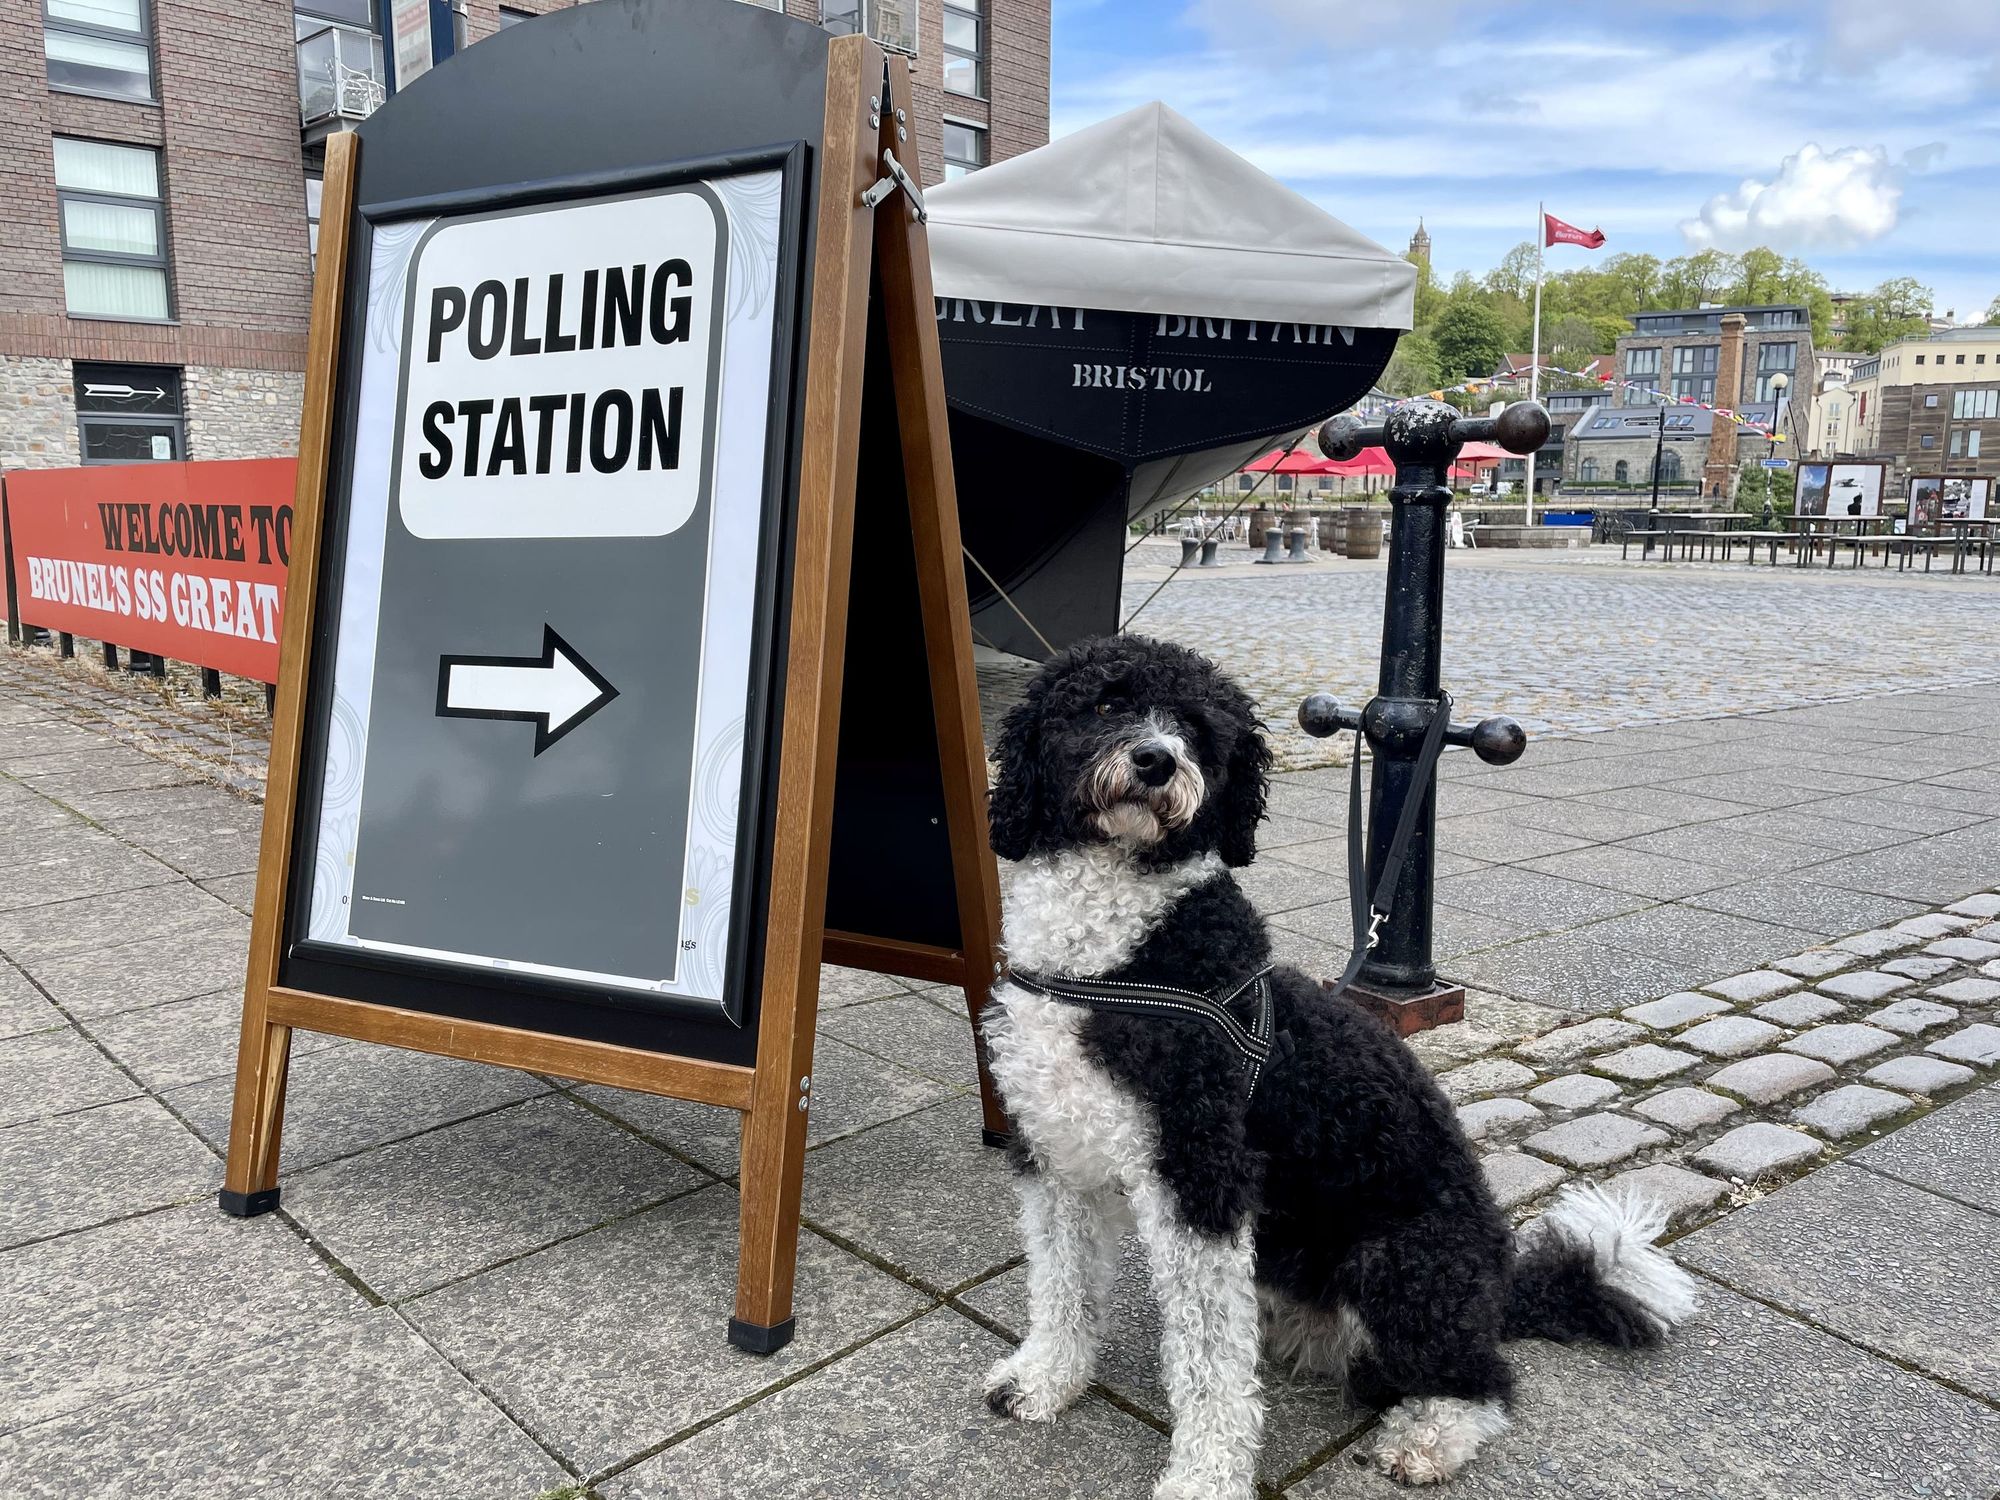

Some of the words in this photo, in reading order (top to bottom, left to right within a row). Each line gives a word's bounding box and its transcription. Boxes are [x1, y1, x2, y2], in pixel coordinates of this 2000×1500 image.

[427, 258, 693, 363] POLLING
[1072, 363, 1212, 392] BRISTOL
[419, 386, 684, 480] STATION
[97, 502, 246, 563] WELCOME
[249, 504, 294, 568] TO
[26, 556, 131, 617] BRUNEL'S
[134, 567, 168, 624] SS
[170, 571, 280, 645] GREAT
